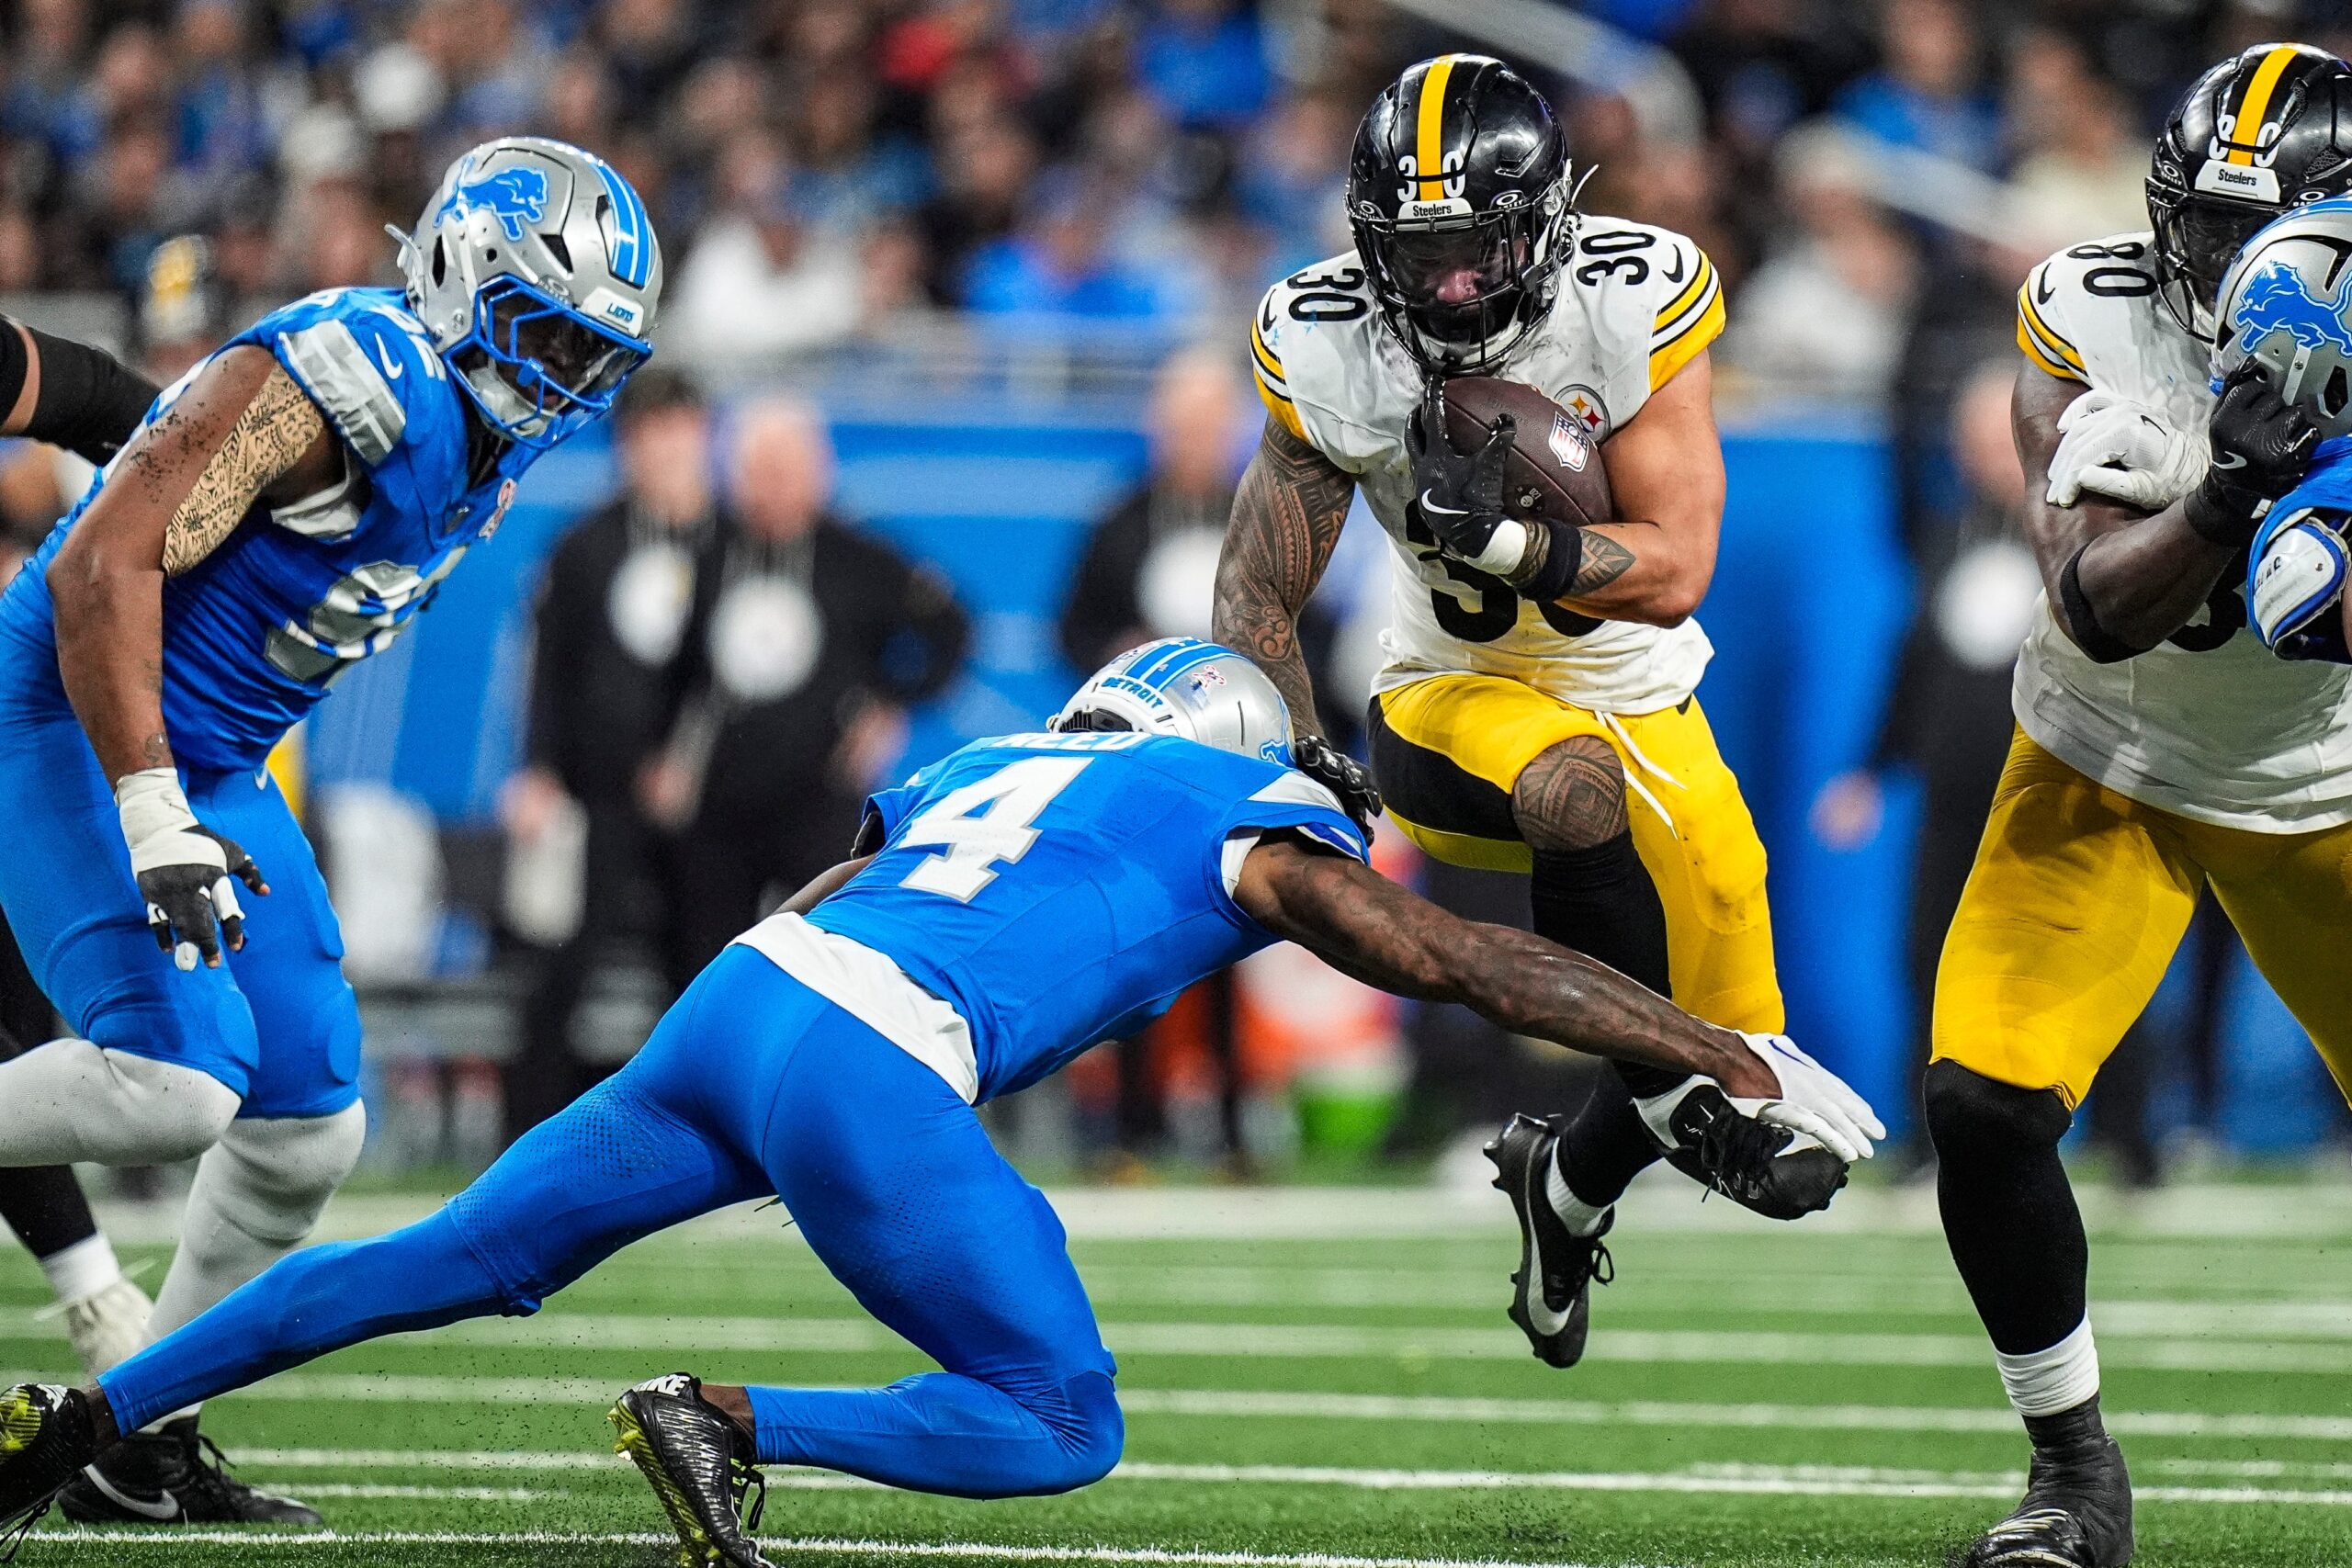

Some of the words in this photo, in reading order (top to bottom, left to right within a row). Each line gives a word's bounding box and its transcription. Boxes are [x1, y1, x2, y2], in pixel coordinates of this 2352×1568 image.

[2209, 114, 2281, 167] 80
[1396, 151, 1466, 202] 30
[2218, 168, 2257, 186] Steelers
[1412, 203, 1453, 218] Steelers
[1576, 231, 1657, 287] 30
[2066, 242, 2159, 297] 80
[1286, 267, 1368, 321] 30
[1102, 676, 1164, 708] DETROIT
[897, 755, 1095, 903] 4
